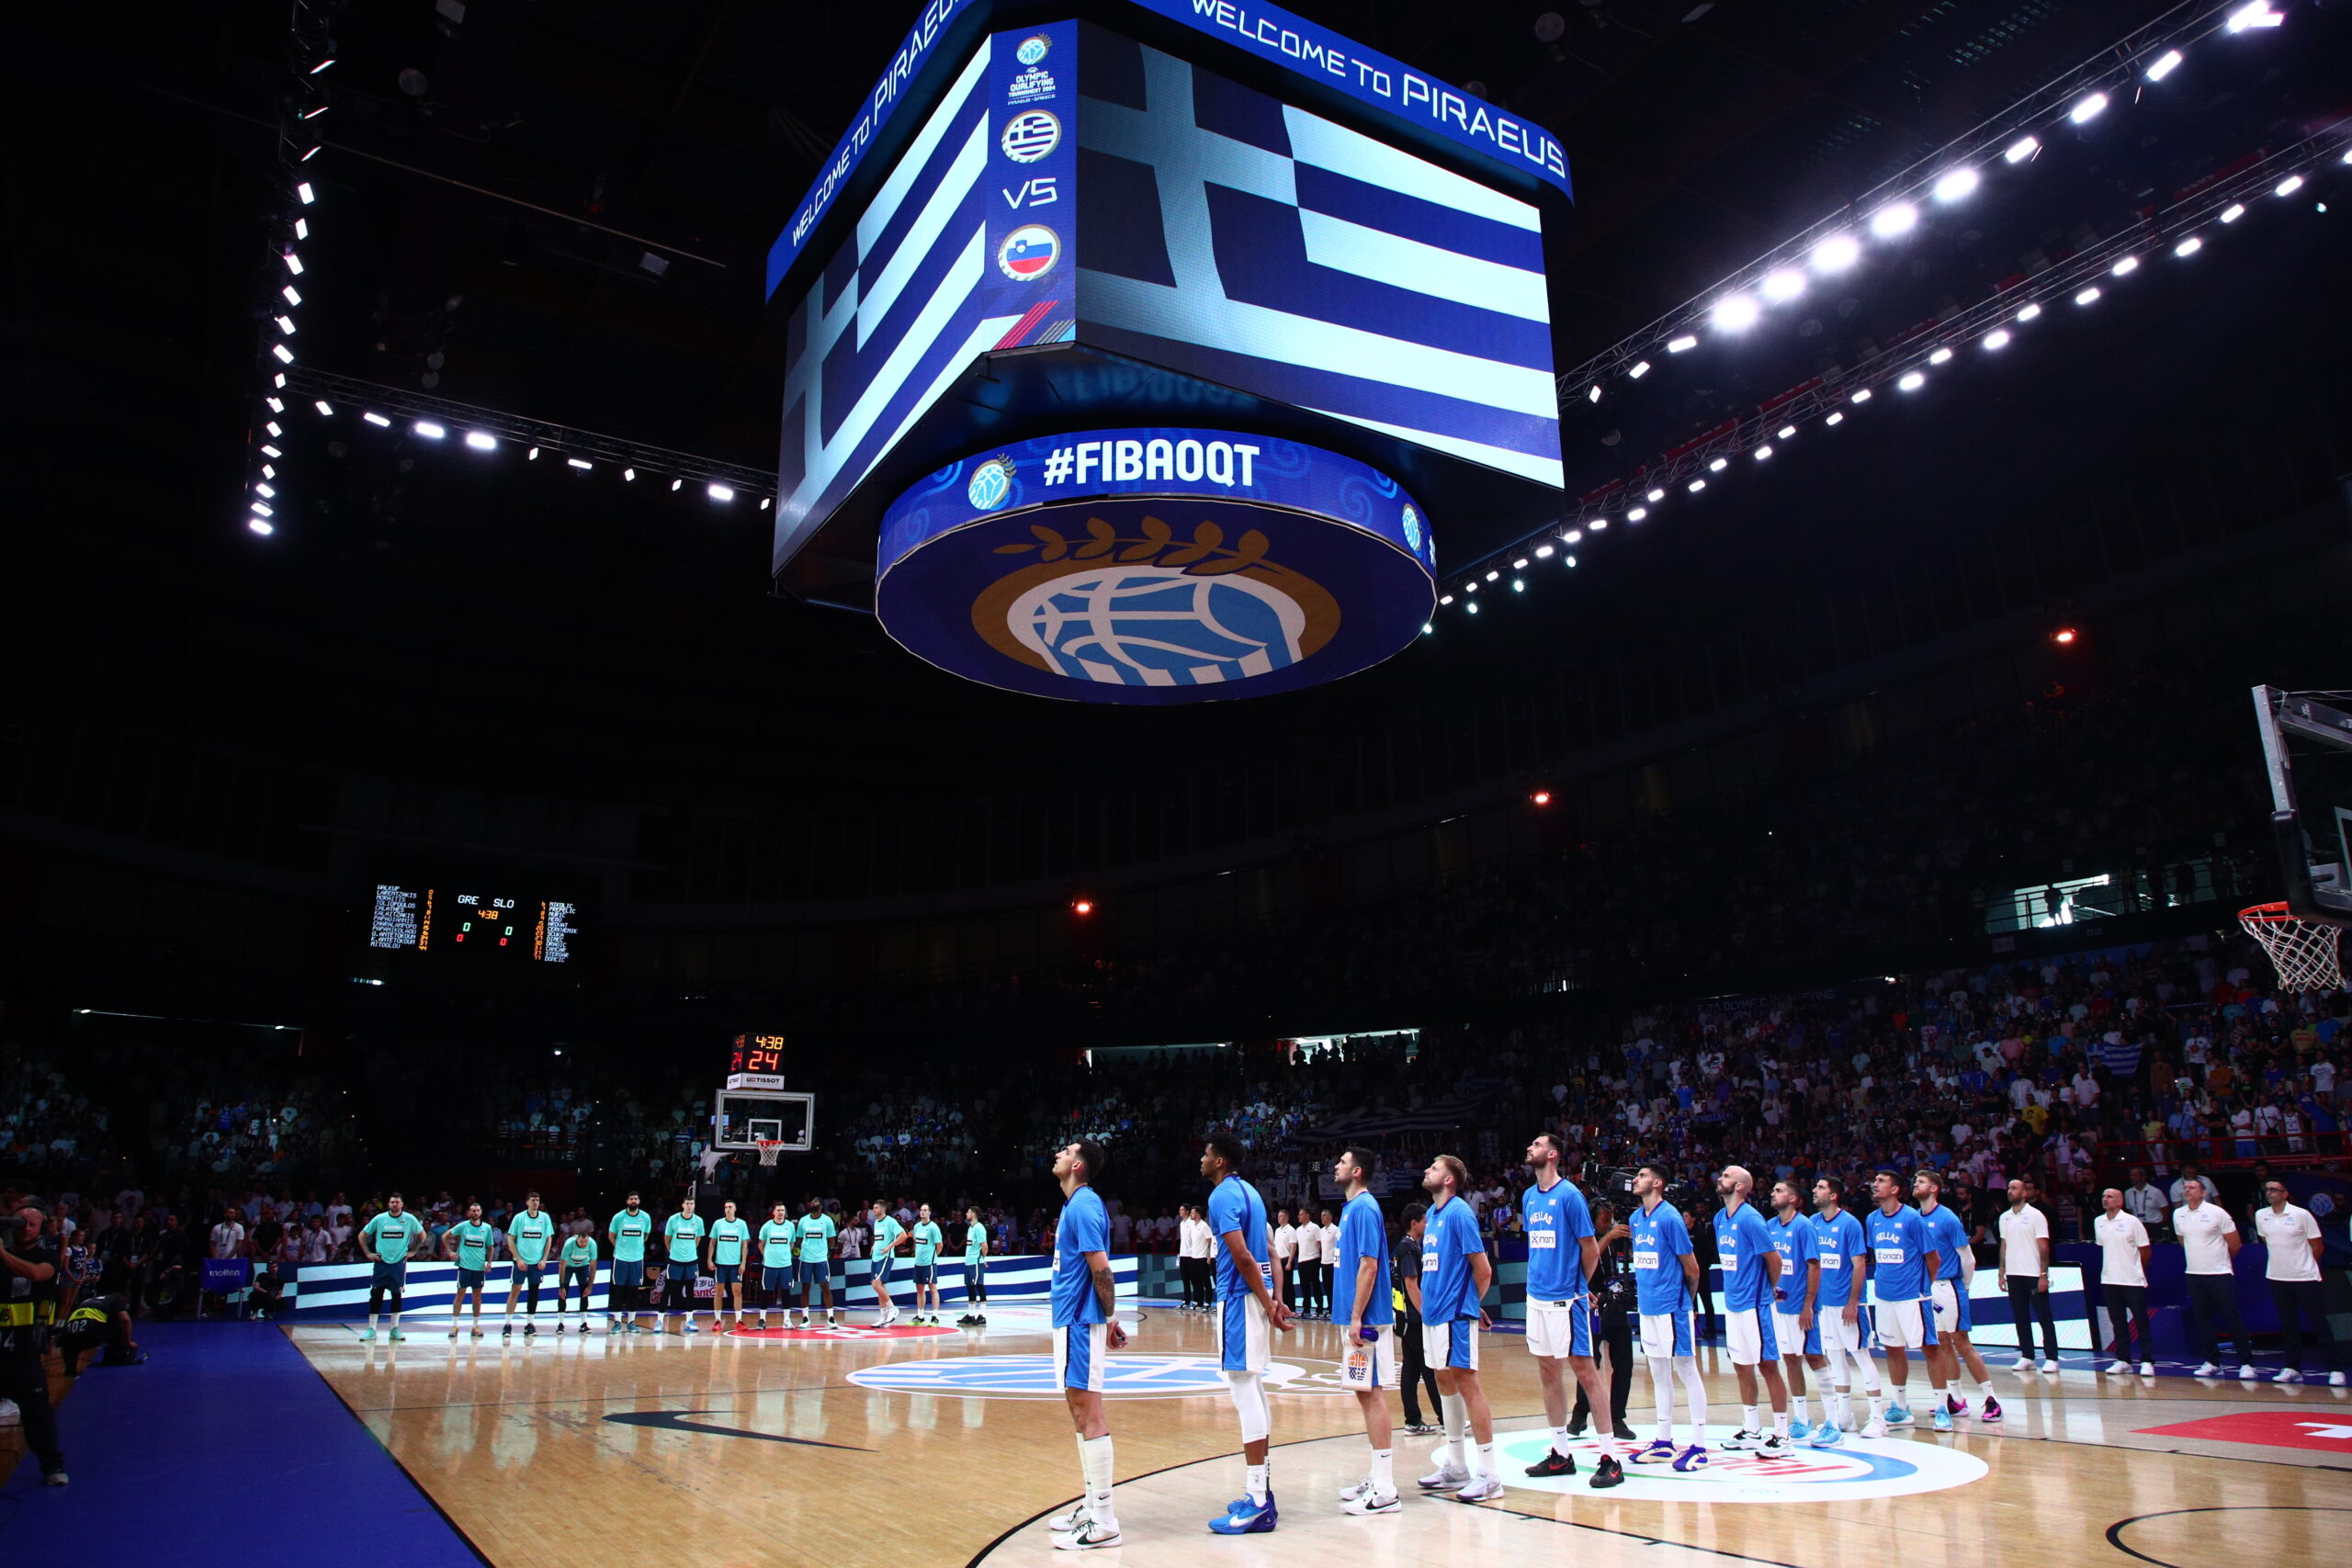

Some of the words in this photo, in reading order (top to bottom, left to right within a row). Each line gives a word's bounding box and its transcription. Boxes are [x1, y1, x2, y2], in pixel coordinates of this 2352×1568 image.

[1010, 77, 1054, 92] QUALIFYING
[1015, 71, 1048, 84] OLYMPIC
[1008, 87, 1041, 98] TOURNAMENT
[1191, 0, 1346, 78] WELCOME
[1351, 59, 1392, 97] TO
[1403, 73, 1566, 179] PIRAEUS
[793, 145, 850, 246] WELCOME
[852, 115, 870, 154] TO
[875, 0, 961, 126] PIRAEU
[1002, 177, 1057, 210] VS
[1044, 438, 1261, 489] #FIBAOQT
[458, 895, 481, 906] GRE
[492, 897, 514, 908] SLO
[462, 921, 471, 932] 0
[504, 926, 514, 936] 0
[456, 933, 465, 942] 0
[499, 937, 507, 946] 0
[755, 1035, 785, 1050] 4:38
[748, 1050, 780, 1071] 24
[1529, 1211, 1554, 1225] HELLAS
[1634, 1232, 1656, 1247] HELLAS
[1818, 1235, 1838, 1249] ELLAS
[1875, 1231, 1901, 1245] HELLAS
[1773, 1241, 1792, 1254] ELLAS
[209, 1268, 241, 1278] molten
[66, 1319, 88, 1334] 102
